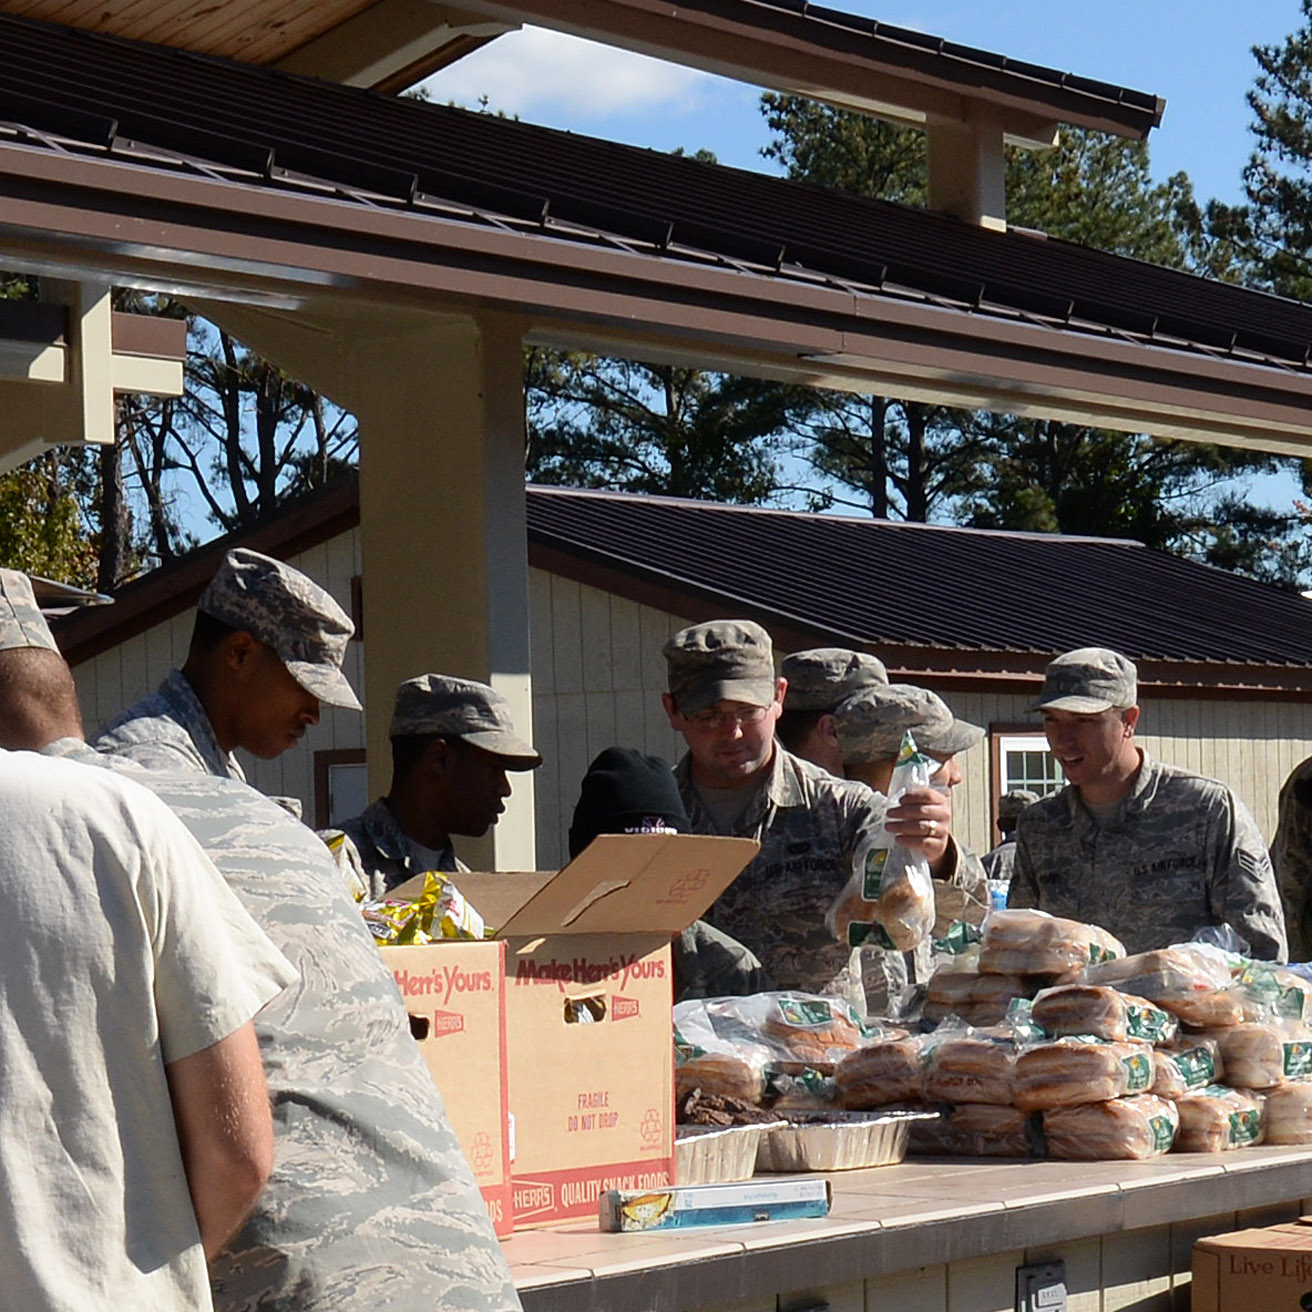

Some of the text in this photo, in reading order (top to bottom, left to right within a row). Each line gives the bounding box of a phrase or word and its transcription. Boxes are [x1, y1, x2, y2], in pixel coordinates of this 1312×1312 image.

[515, 957, 573, 993] Make
[573, 957, 620, 984] Herr's
[577, 1092, 609, 1110] FRAGILE
[568, 1111, 619, 1132] DO NOT DROP
[561, 1180, 602, 1208] QUALITY
[637, 1171, 670, 1191] FOODS
[1228, 1254, 1273, 1276] Live
